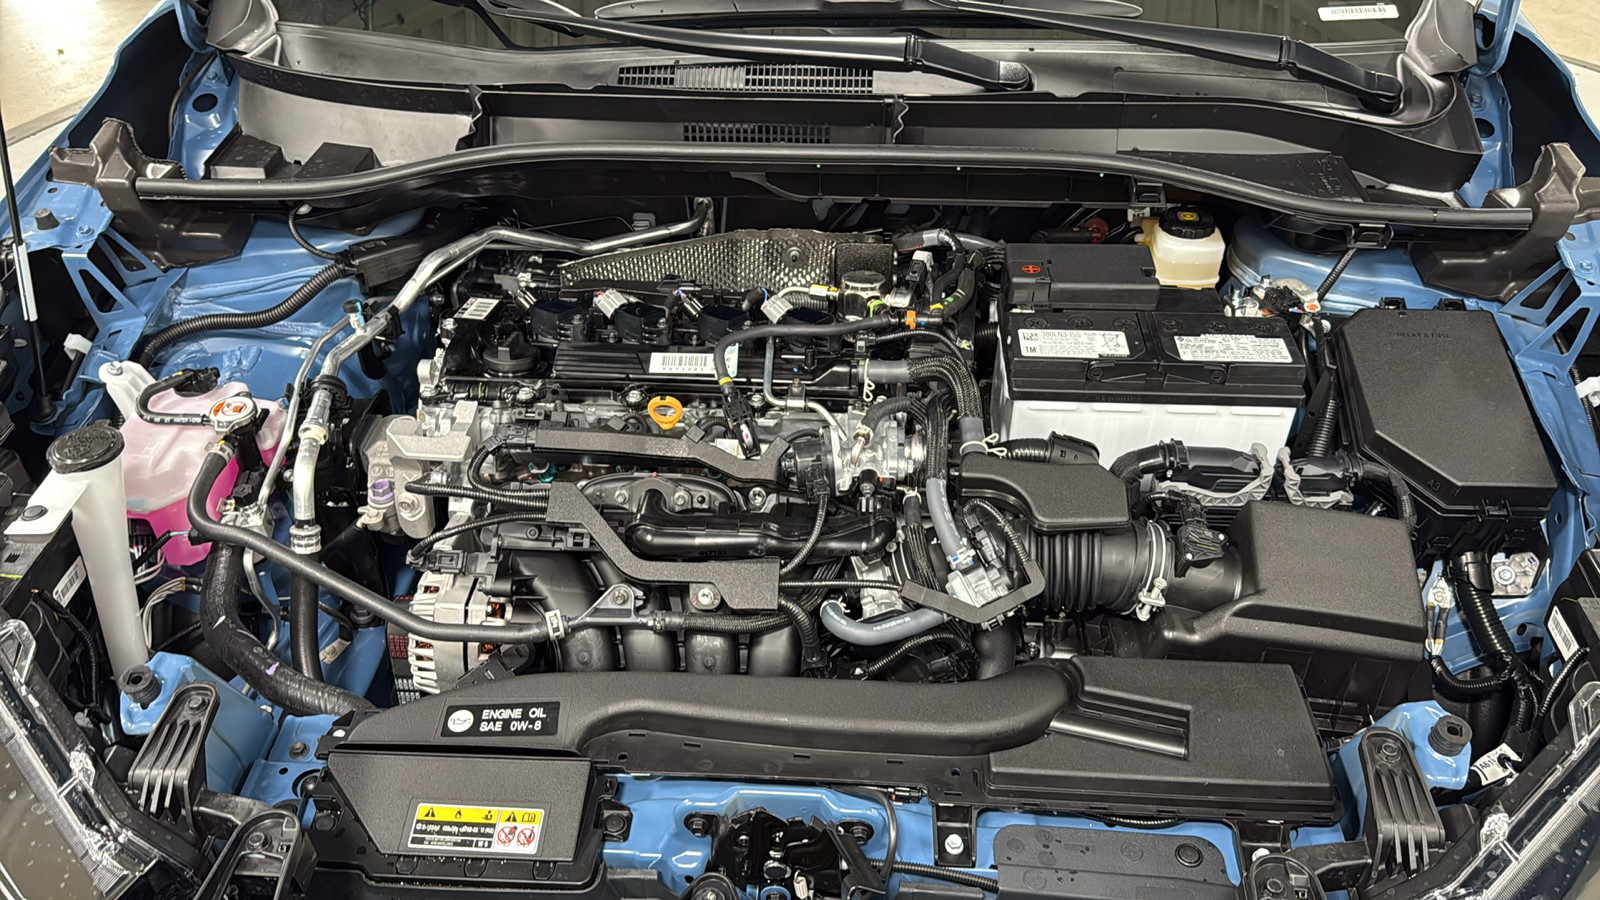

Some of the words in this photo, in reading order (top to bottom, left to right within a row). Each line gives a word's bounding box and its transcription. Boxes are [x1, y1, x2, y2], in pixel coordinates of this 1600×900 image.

[481, 708, 523, 720] ENGINE
[528, 707, 547, 718] OIL
[479, 721, 504, 732] SAE
[510, 720, 542, 732] 0W-8
